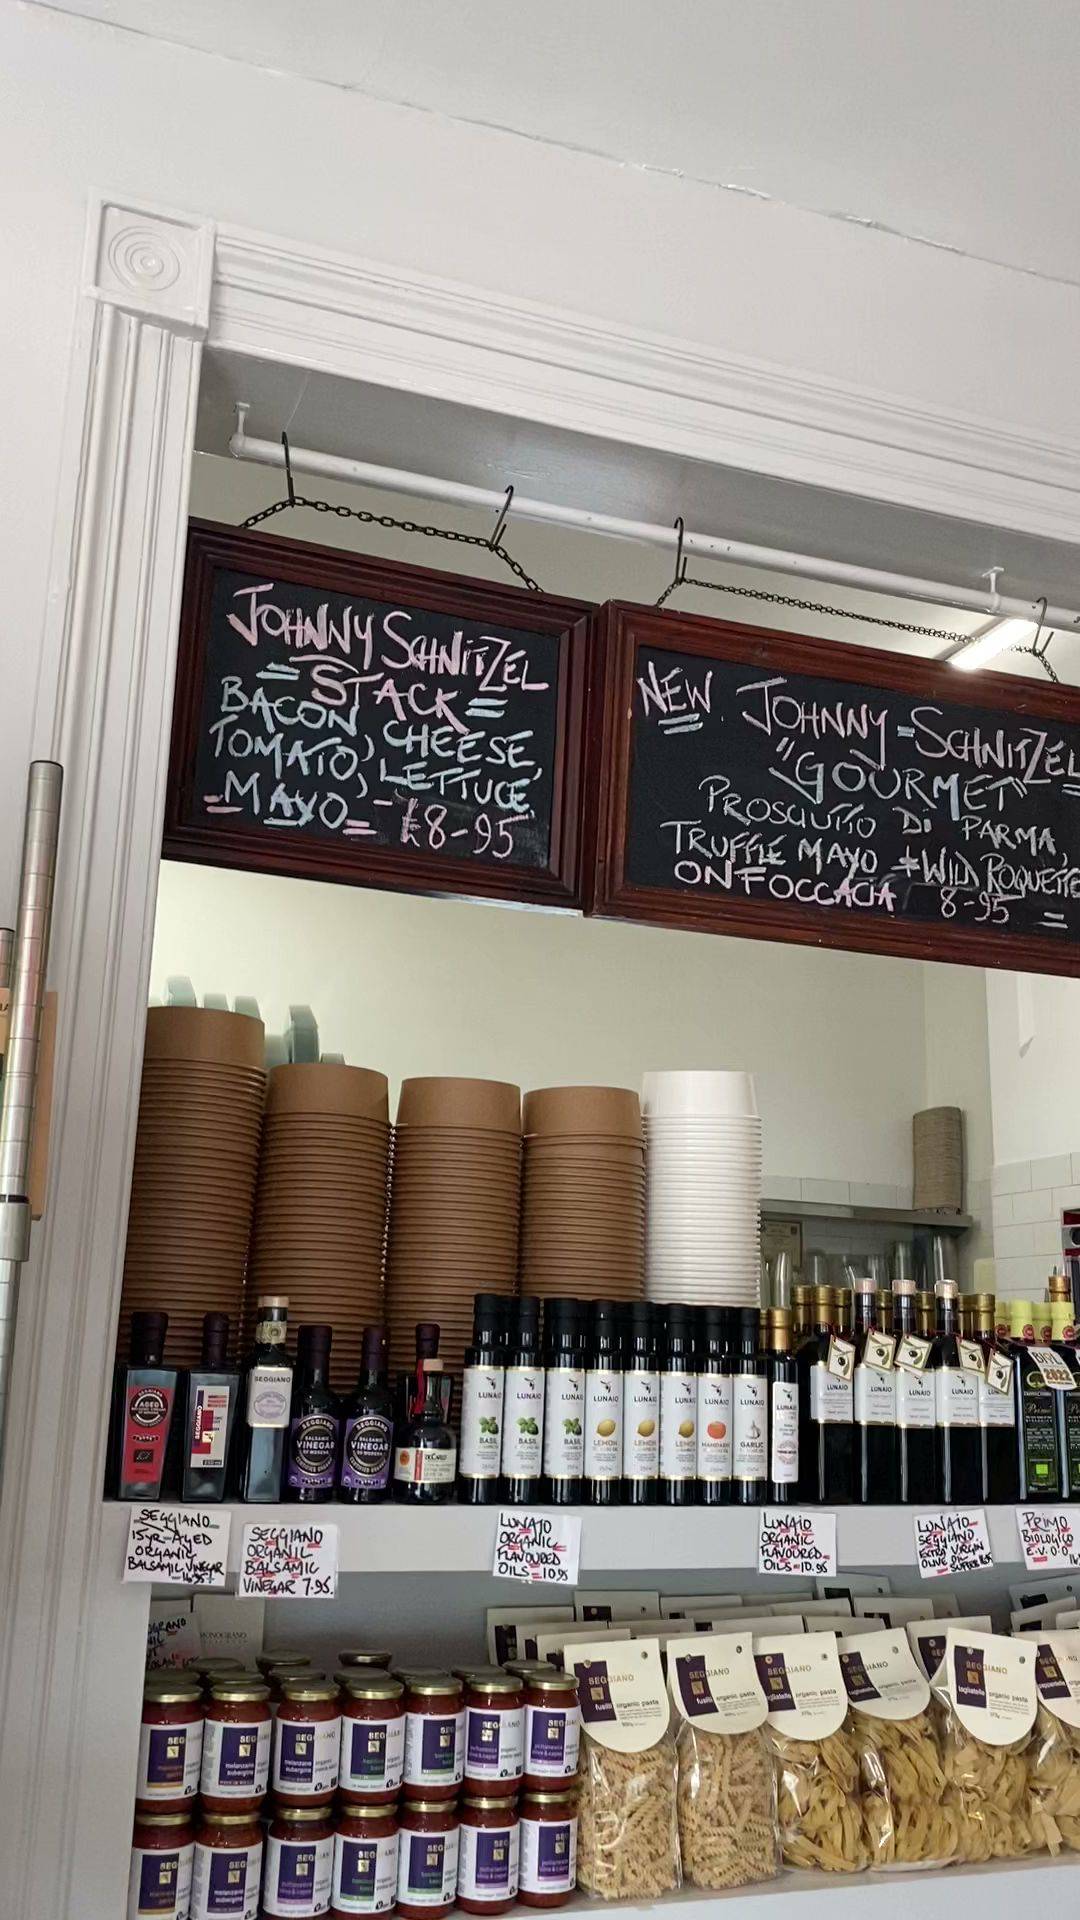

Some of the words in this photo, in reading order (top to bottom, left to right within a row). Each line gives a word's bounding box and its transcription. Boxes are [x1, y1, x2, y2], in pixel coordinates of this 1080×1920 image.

[227, 583, 373, 670] JOHNNY
[311, 661, 471, 733] STACK
[636, 661, 713, 716] NEW
[736, 677, 889, 771] JOHNNY
[659, 820, 787, 865] TRUFFLE
[798, 837, 879, 886] MAYO
[673, 858, 734, 890] ON
[516, 1392, 542, 1400] LUNAIO
[870, 1385, 893, 1393] LUNAIO
[296, 1440, 336, 1449] VINEGAR
[350, 1441, 389, 1451] VINEGAR
[139, 1508, 210, 1531] SEGGIANO
[249, 1526, 323, 1548] SEGGIANO
[761, 1531, 815, 1548] ORGANIC
[135, 1545, 197, 1565] ORGANIC
[247, 1544, 314, 1563] ORGANIC
[128, 1557, 184, 1577] BALSAMIC
[244, 1560, 320, 1578] BALSAMIC
[497, 1562, 530, 1577] OILS
[763, 1558, 793, 1572] OILS
[241, 1577, 297, 1595] VINEGAR
[688, 1667, 730, 1679] SEGGIANO
[767, 1664, 812, 1675] SEGGIANO
[966, 1660, 1008, 1675] SEGGIANO
[588, 1673, 634, 1685] SEGGIANO
[819, 1688, 837, 1696] pasta
[1012, 1695, 1029, 1703] pasta
[641, 1699, 659, 1708] pasta
